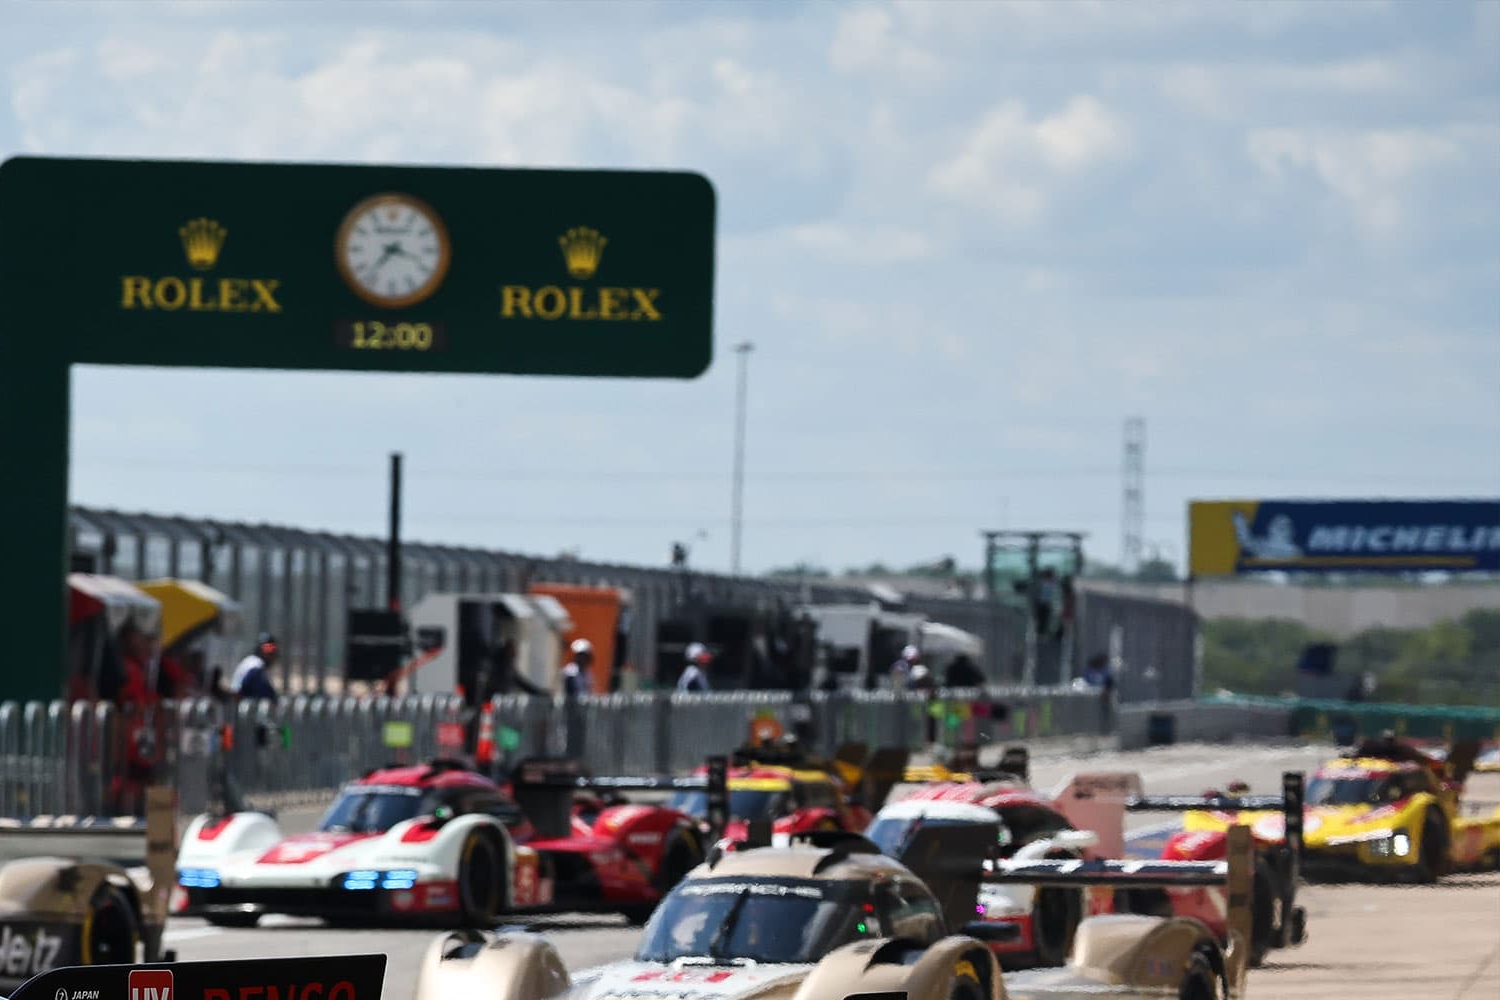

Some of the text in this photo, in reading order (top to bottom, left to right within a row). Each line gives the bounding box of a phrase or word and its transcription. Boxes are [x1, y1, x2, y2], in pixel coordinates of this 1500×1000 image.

[121, 277, 282, 312] ROLEX
[501, 286, 661, 321] ROLEX
[352, 323, 432, 350] 12:00
[71, 990, 100, 1000] JAPAN
